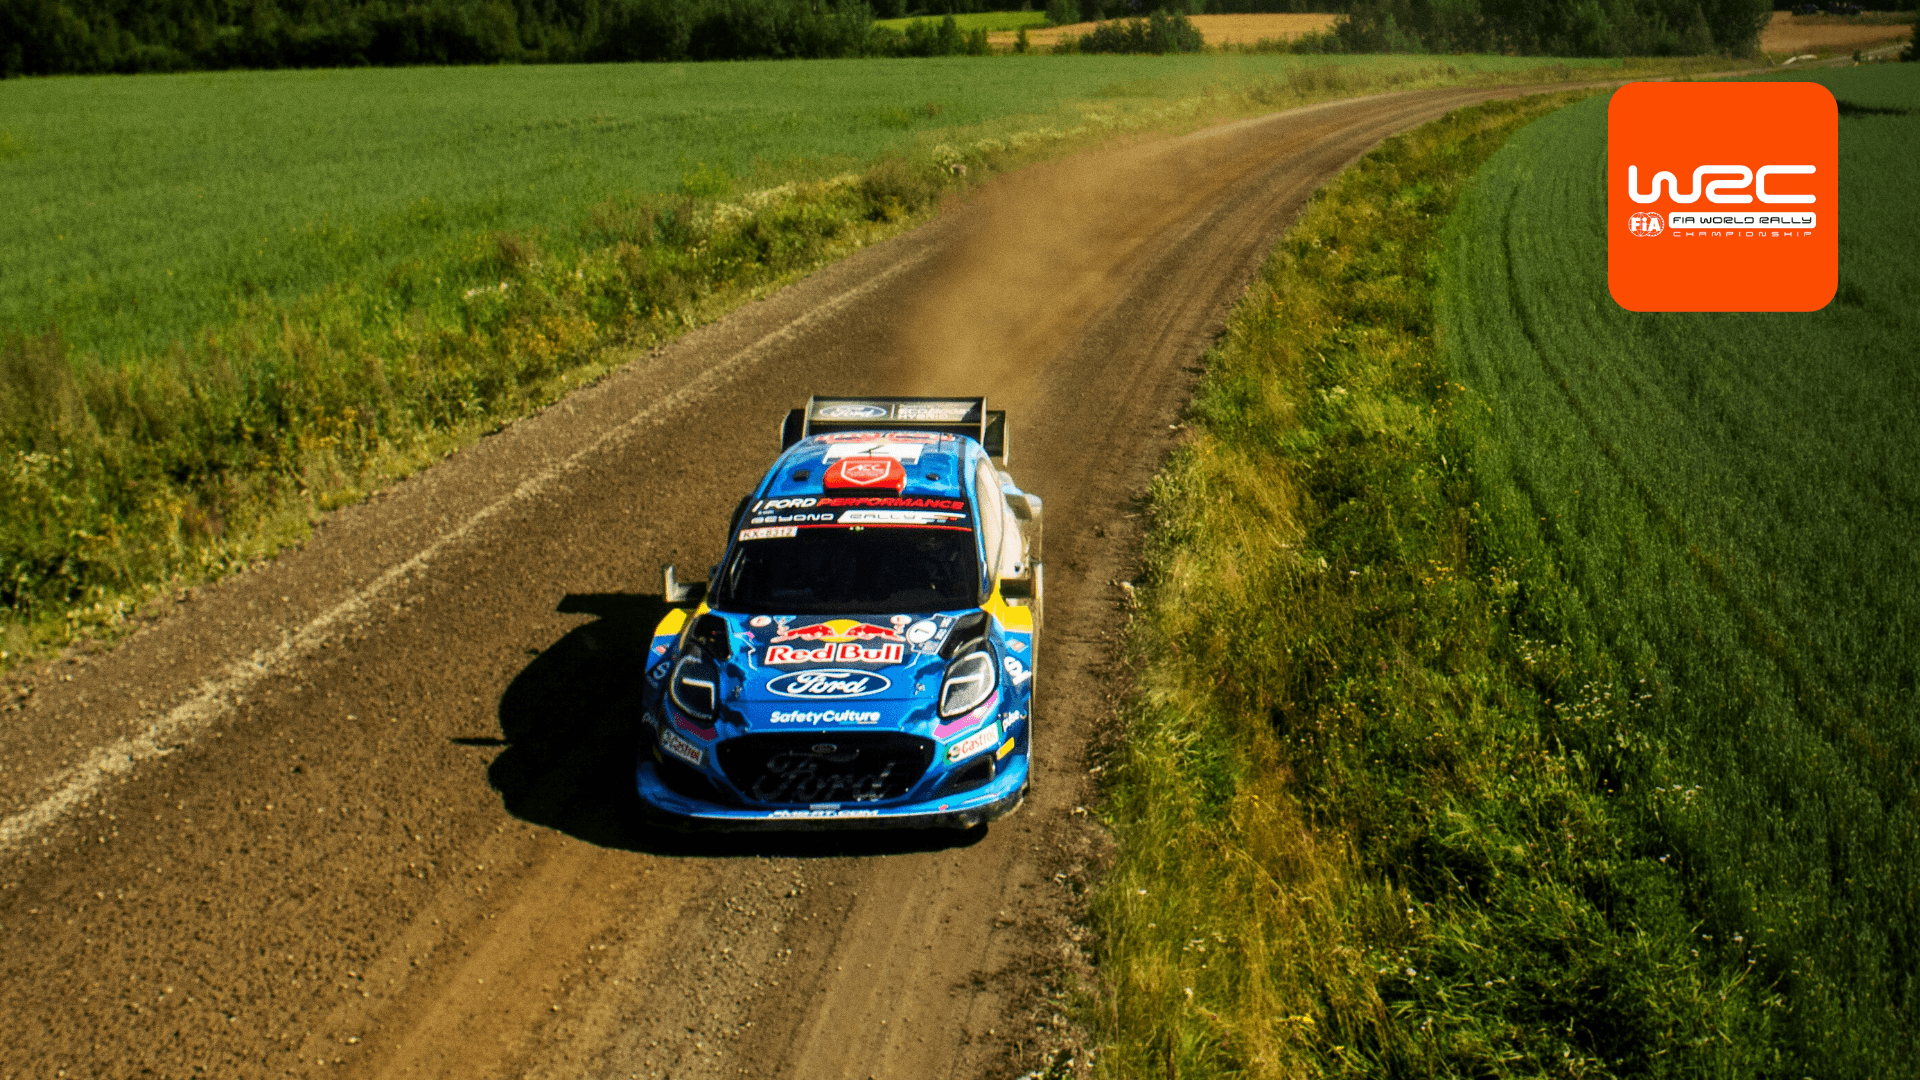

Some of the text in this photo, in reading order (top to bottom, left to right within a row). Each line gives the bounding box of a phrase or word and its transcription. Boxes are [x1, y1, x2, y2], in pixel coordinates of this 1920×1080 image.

[764, 497, 964, 510] FORD PERFORMANCE
[750, 513, 835, 524] BEYOND
[767, 643, 903, 663] Red Bull
[786, 672, 870, 694] Ford
[770, 710, 881, 725] SafetyCulture
[962, 727, 996, 754] Castrol
